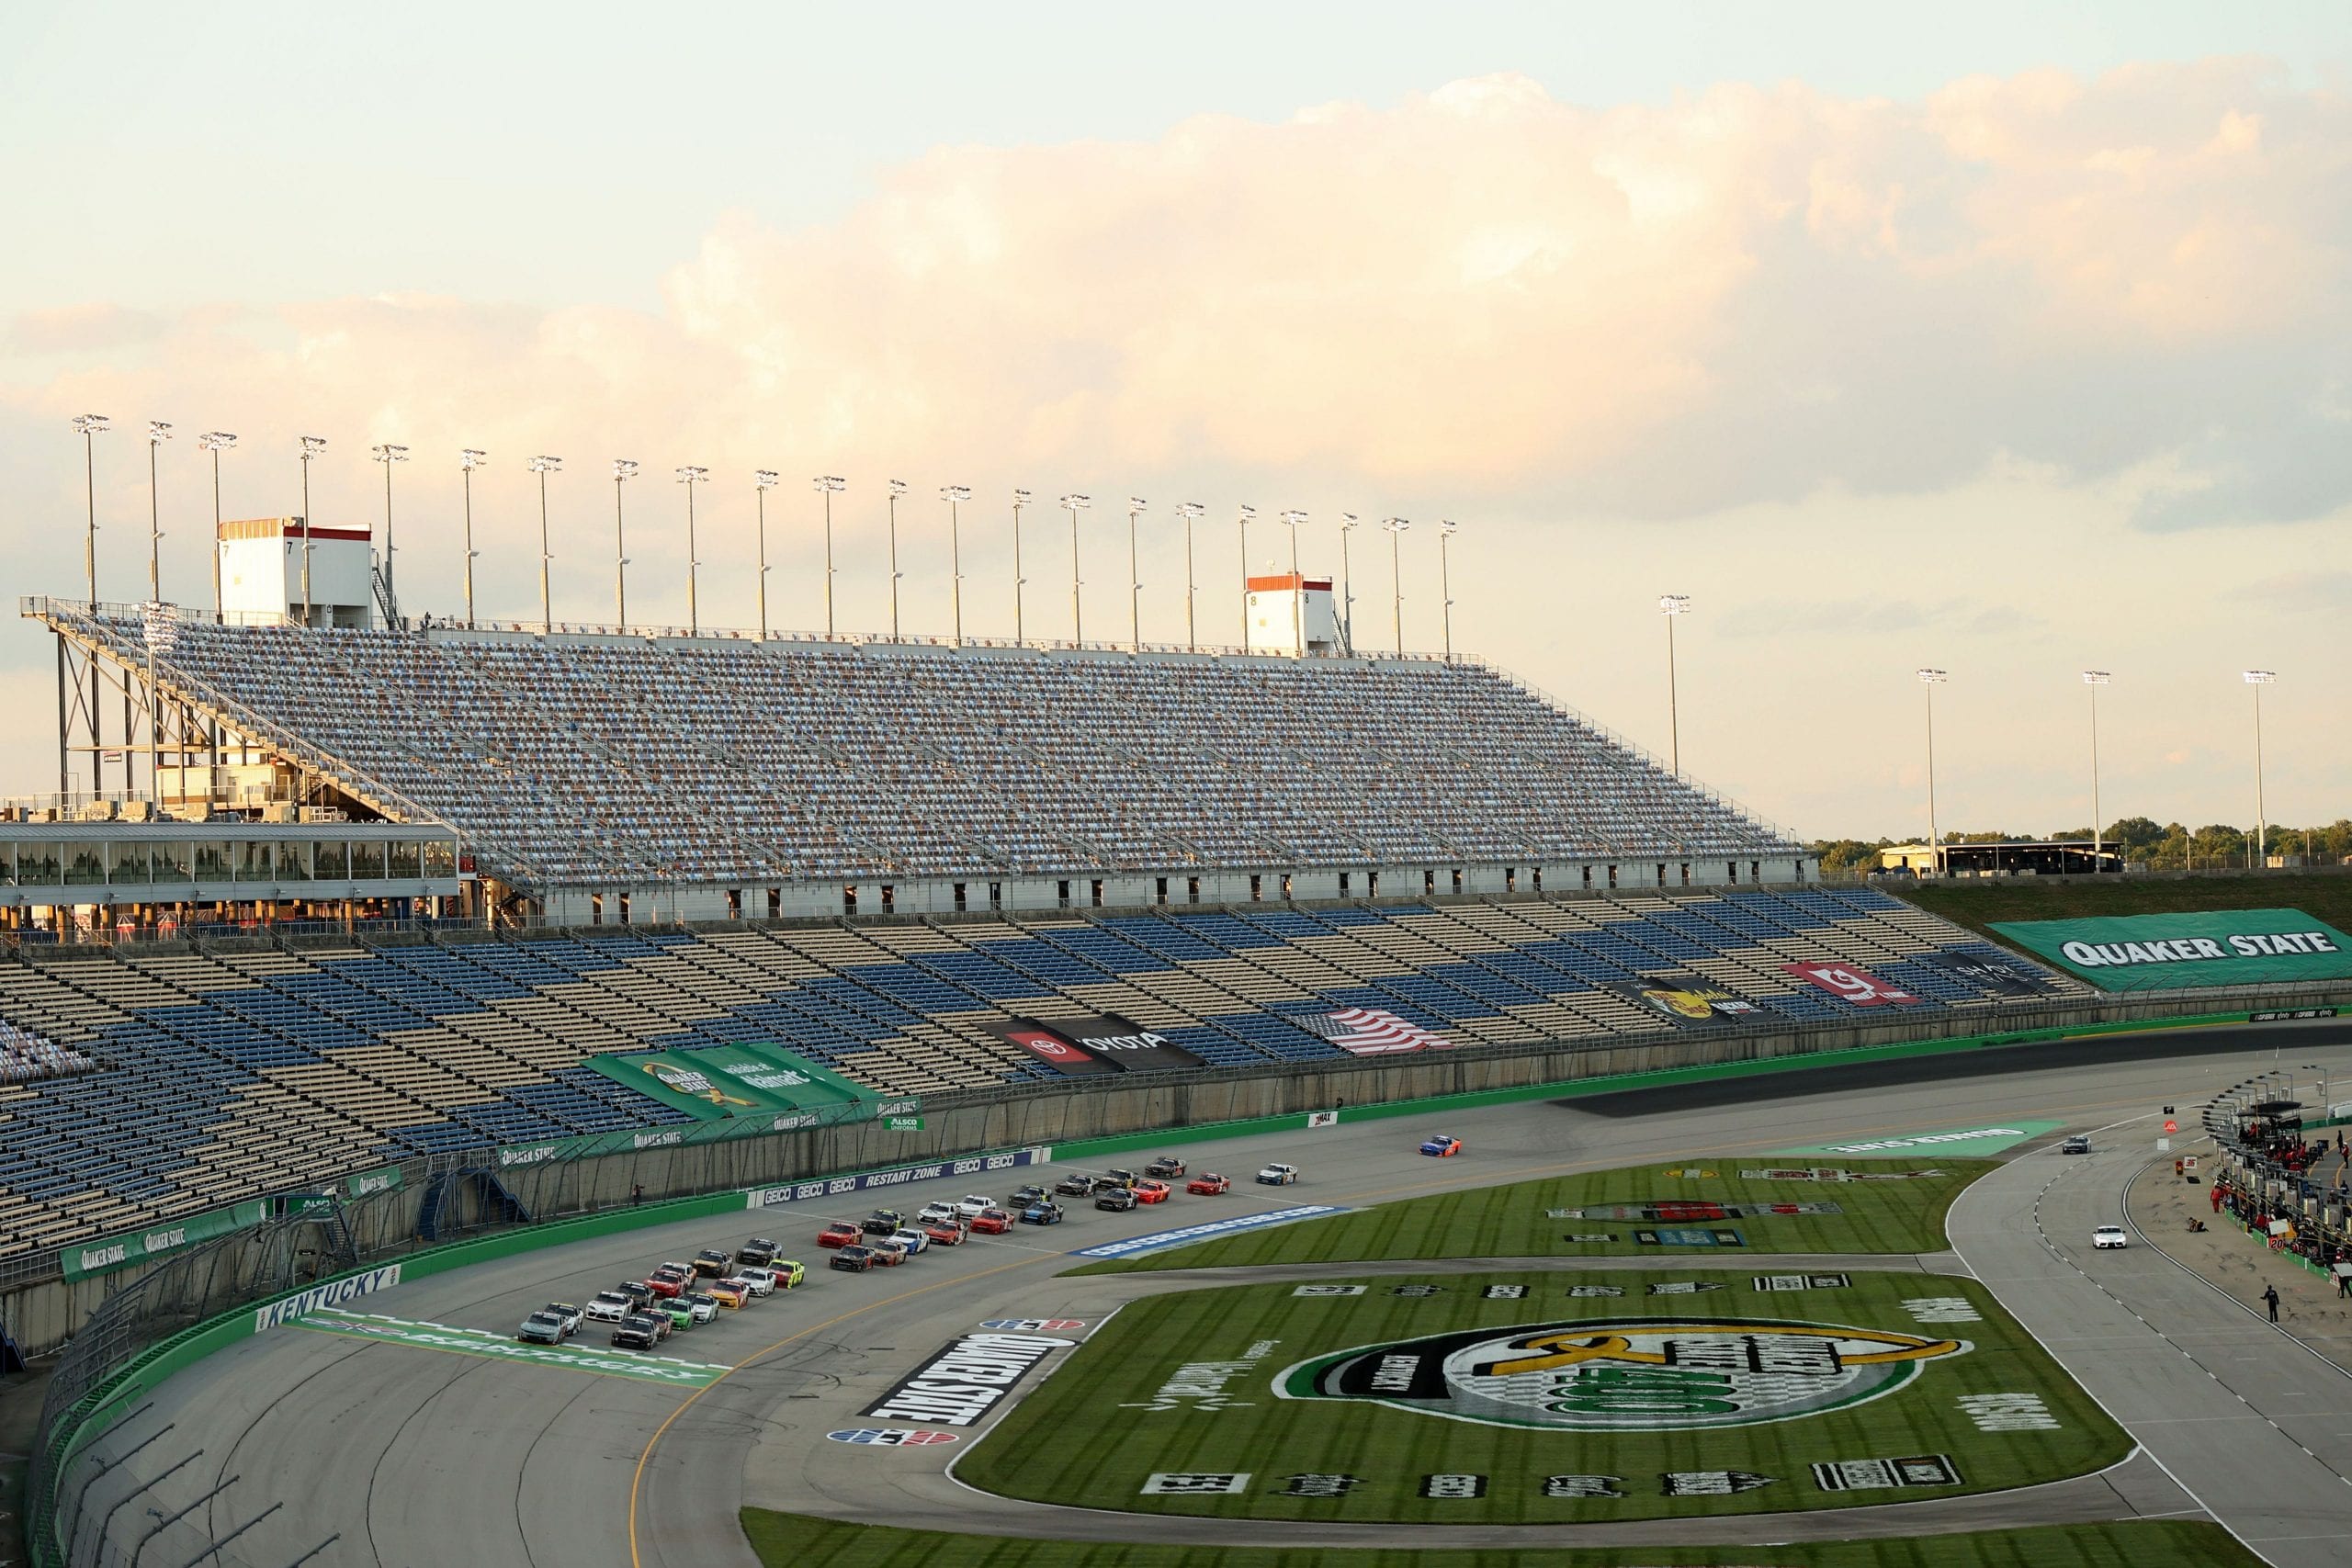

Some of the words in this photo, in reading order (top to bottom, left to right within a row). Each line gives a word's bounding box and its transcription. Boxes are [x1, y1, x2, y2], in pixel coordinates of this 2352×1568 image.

[287, 541, 293, 554] 7
[2063, 938, 2229, 967] QUAKER
[2228, 932, 2339, 957] STATE
[1076, 1032, 1169, 1052] OYOTA
[657, 1072, 707, 1084] QUAKER
[681, 1081, 715, 1092] STATE
[877, 1103, 901, 1117] QUAKER
[901, 1101, 917, 1113] STATE
[774, 1117, 798, 1131] QUAKER
[799, 1115, 816, 1127] STATE
[634, 1134, 662, 1148] QUAKER
[662, 1132, 683, 1145] STATE
[502, 1150, 533, 1166] QUAKER
[535, 1146, 556, 1161] STATE
[765, 1187, 791, 1204] GEICO
[797, 1183, 823, 1200] GEICO
[829, 1178, 856, 1195] GEICO
[865, 1168, 912, 1188] RESTART
[912, 1166, 943, 1180] ZONE
[953, 1159, 980, 1175] GEICO
[986, 1154, 1014, 1171] GEICO
[146, 1233, 170, 1253] QUAKER
[169, 1228, 185, 1247] STATE
[81, 1250, 107, 1271] QUAKER
[107, 1244, 126, 1264] STATE
[267, 1269, 387, 1328] KENTUCKY
